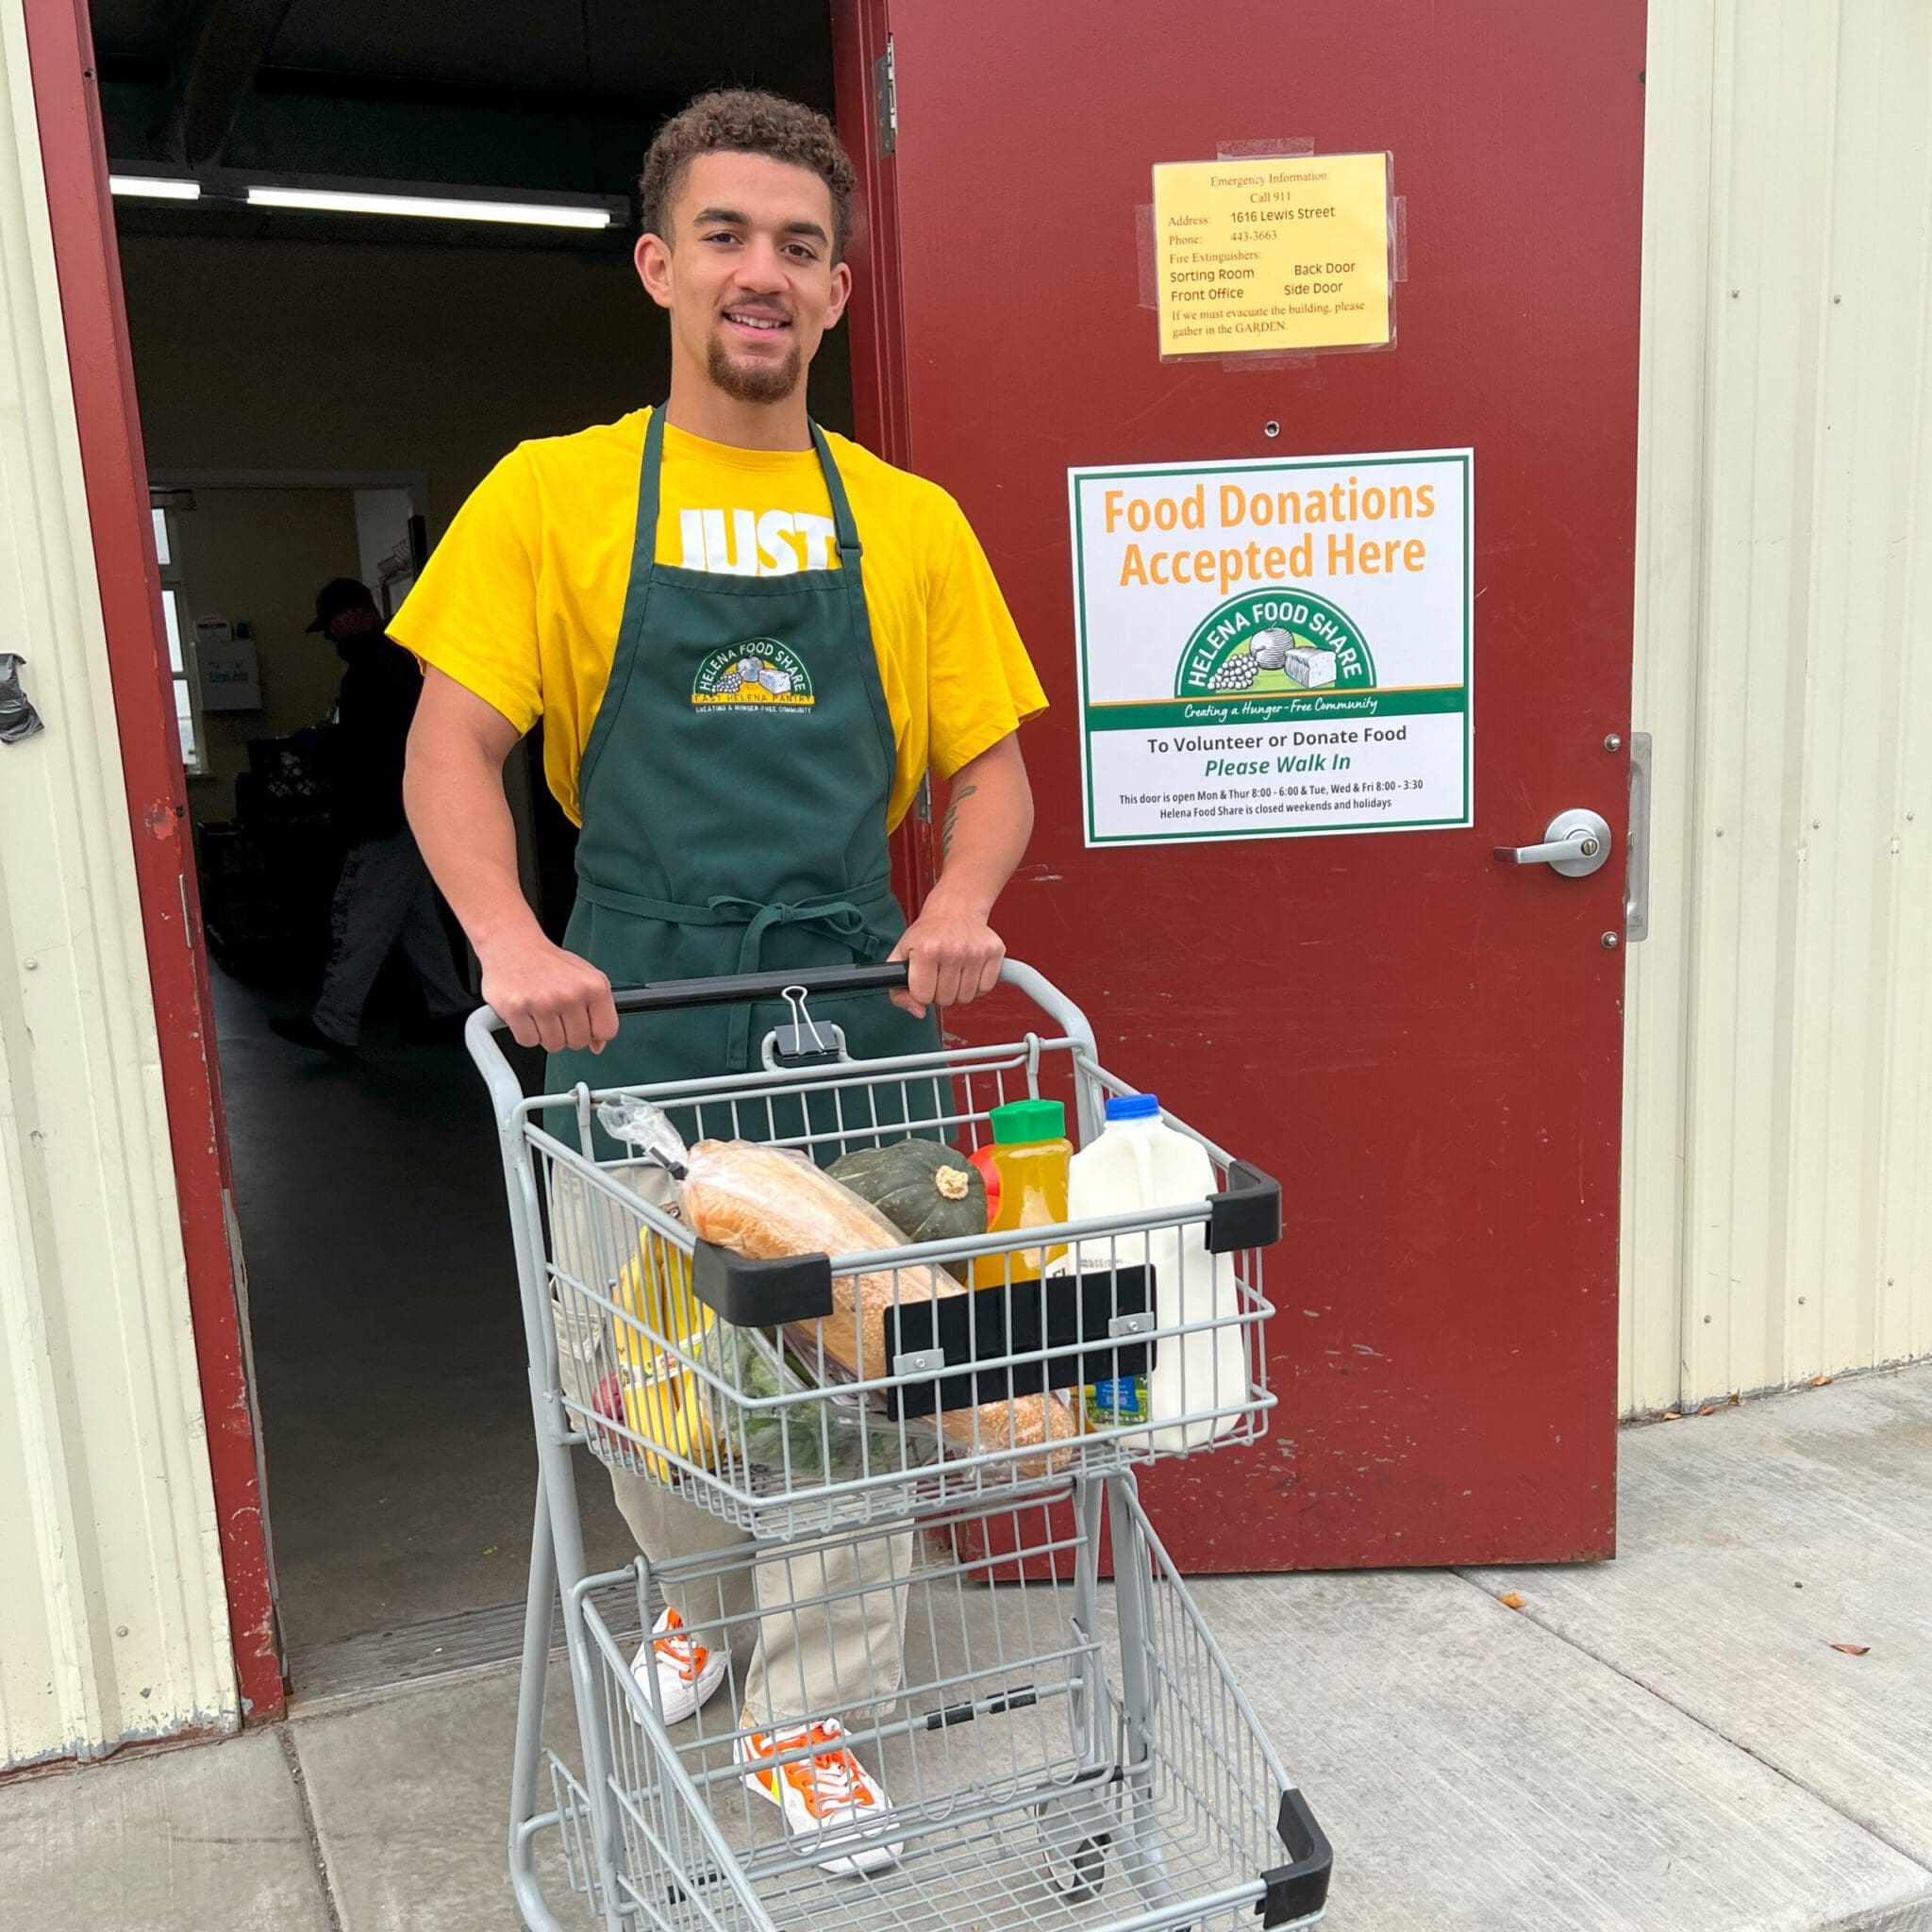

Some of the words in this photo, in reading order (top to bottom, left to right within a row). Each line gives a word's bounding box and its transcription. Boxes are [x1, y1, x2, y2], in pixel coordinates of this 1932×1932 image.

[1211, 175, 1265, 188] Emergency
[1250, 192, 1270, 203] Call
[1274, 191, 1291, 202] 911
[1230, 211, 1257, 223] 1616
[1261, 209, 1293, 222] Lewis
[1297, 207, 1336, 219] Street
[1169, 235, 1202, 245] Phone:
[1230, 230, 1277, 242] 443-3663
[1170, 254, 1189, 264] Fire
[1192, 249, 1261, 264] Extinguishers:
[1170, 270, 1215, 283] Sorting
[1219, 268, 1255, 280] Room
[1294, 263, 1323, 275] Back
[1325, 262, 1356, 274] Door
[1171, 290, 1205, 302] Front
[1208, 288, 1244, 300] Office
[1284, 284, 1310, 296] Side
[1313, 282, 1343, 294] Door
[1172, 310, 1181, 321] If
[1200, 309, 1224, 320] must
[1226, 308, 1269, 318] evacuate
[1271, 306, 1286, 315] the
[1335, 301, 1365, 314] please
[1173, 325, 1202, 340] gather
[1206, 325, 1215, 335] in
[1218, 324, 1232, 334] the
[1105, 483, 1206, 533] Food
[1220, 476, 1435, 528] Donations
[1120, 532, 1312, 594] Accepted
[1328, 531, 1425, 575] Here
[1188, 611, 1250, 687] HELENA
[1252, 602, 1308, 625] FOOD
[1308, 612, 1362, 679] SHARE
[699, 649, 738, 691] HELENA
[740, 641, 774, 656] FOOD
[774, 650, 806, 692] SHARE
[727, 693, 768, 703] HELENA
[773, 693, 811, 703] PANTRY
[1184, 704, 1228, 724] Creating
[1231, 707, 1239, 716] a
[1241, 699, 1312, 721] Hunger-Free
[1315, 696, 1377, 714] Community
[1147, 739, 1169, 754] To
[1174, 735, 1263, 752] Volunteer
[1269, 734, 1288, 747] or
[1293, 729, 1358, 746] Donate
[1364, 725, 1407, 742] Food
[1205, 758, 1271, 777] Please
[1276, 754, 1326, 773] Walk
[1332, 754, 1351, 771] In
[1120, 793, 1138, 805] This
[1140, 793, 1161, 804] door
[1163, 792, 1171, 803] is
[1173, 792, 1195, 805] open
[1197, 791, 1218, 801] Mon
[1220, 791, 1227, 800] &
[1228, 789, 1250, 799] Thur
[1252, 788, 1272, 798] 8:00
[1279, 786, 1299, 796] 6:00
[1301, 785, 1307, 795] &
[1309, 784, 1329, 796] Tue,
[1330, 782, 1351, 793] Wed
[1353, 783, 1360, 792] &
[1362, 781, 1374, 792] Fri
[1375, 780, 1396, 791] 8:00
[1403, 779, 1424, 790] 3:30
[1160, 808, 1191, 819] Helena
[1193, 806, 1216, 817] Food
[1218, 806, 1243, 816] Share
[1245, 805, 1253, 815] is
[1255, 803, 1284, 814] closed
[1286, 800, 1332, 812] weekends
[1334, 799, 1351, 810] and
[1353, 797, 1392, 811] holidays
